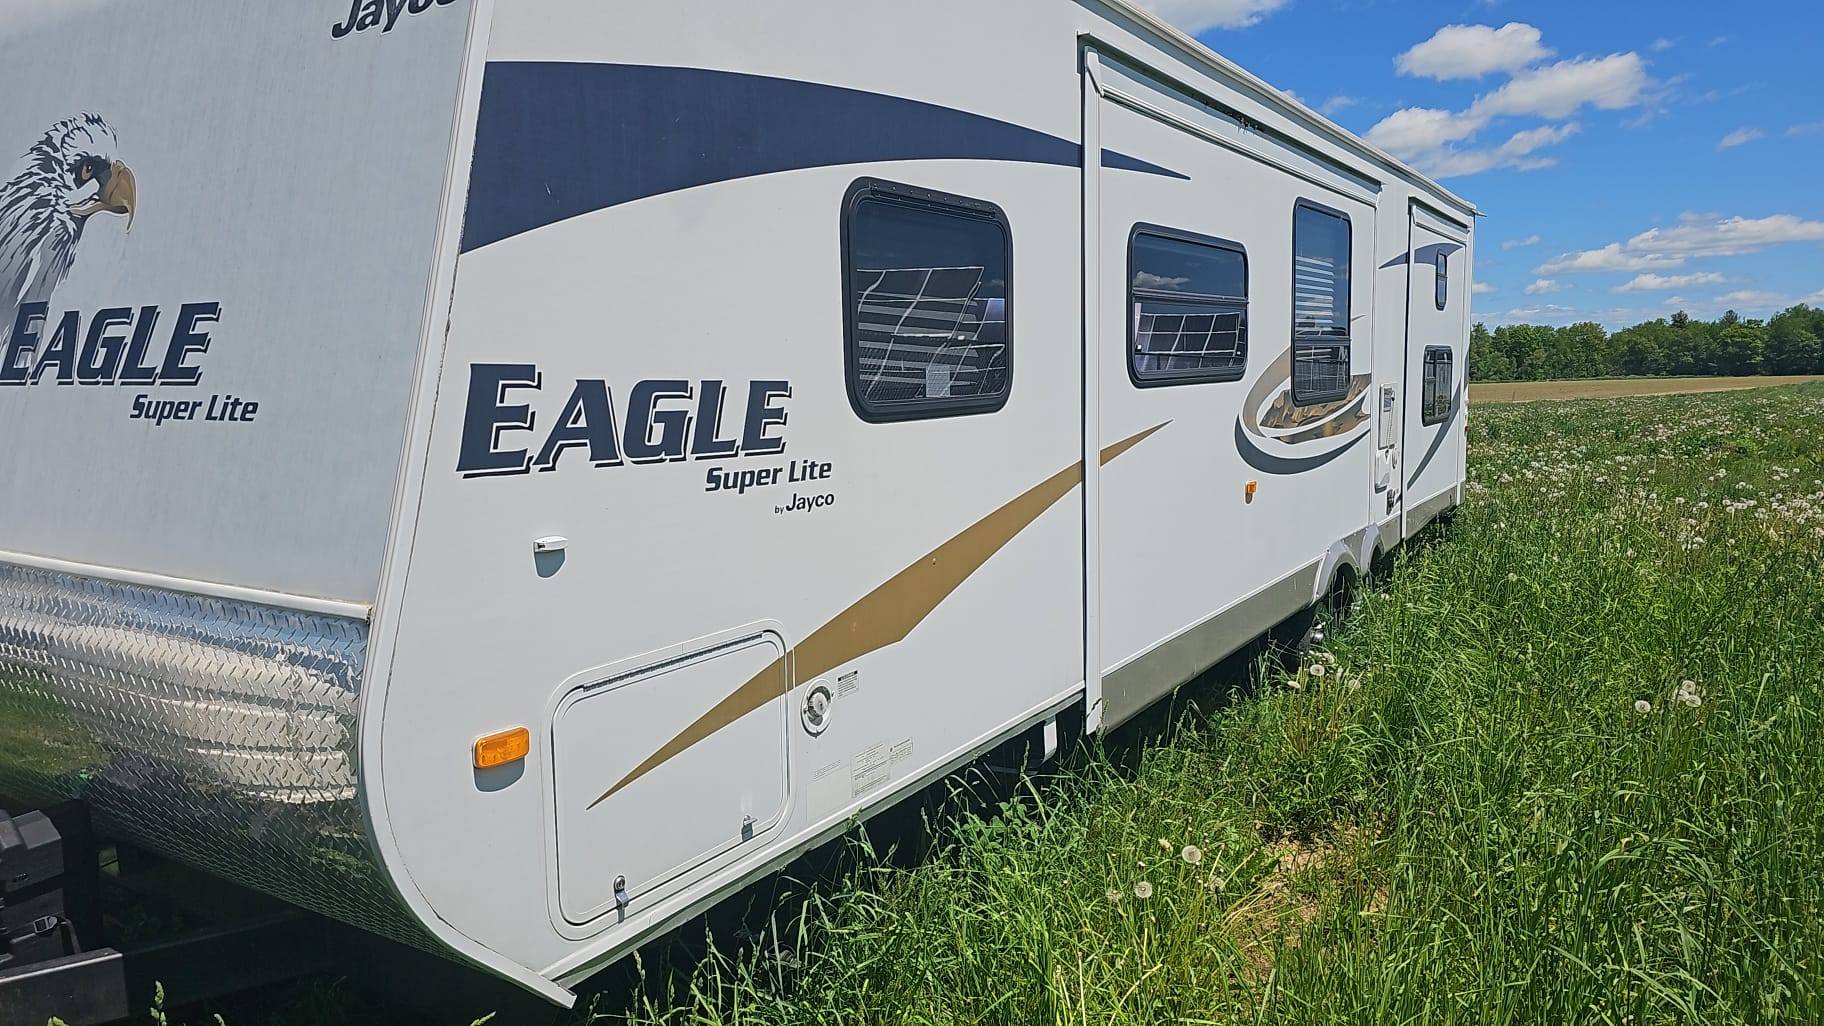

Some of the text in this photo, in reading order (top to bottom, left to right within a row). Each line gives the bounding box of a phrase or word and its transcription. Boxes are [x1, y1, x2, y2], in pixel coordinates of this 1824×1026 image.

[331, 0, 457, 38] Jay
[0, 301, 222, 386] EAGLE
[129, 394, 259, 426] Super Lite
[456, 363, 793, 479] EAGLE
[705, 459, 832, 494] Super Lite
[774, 493, 835, 514] by Jayco
